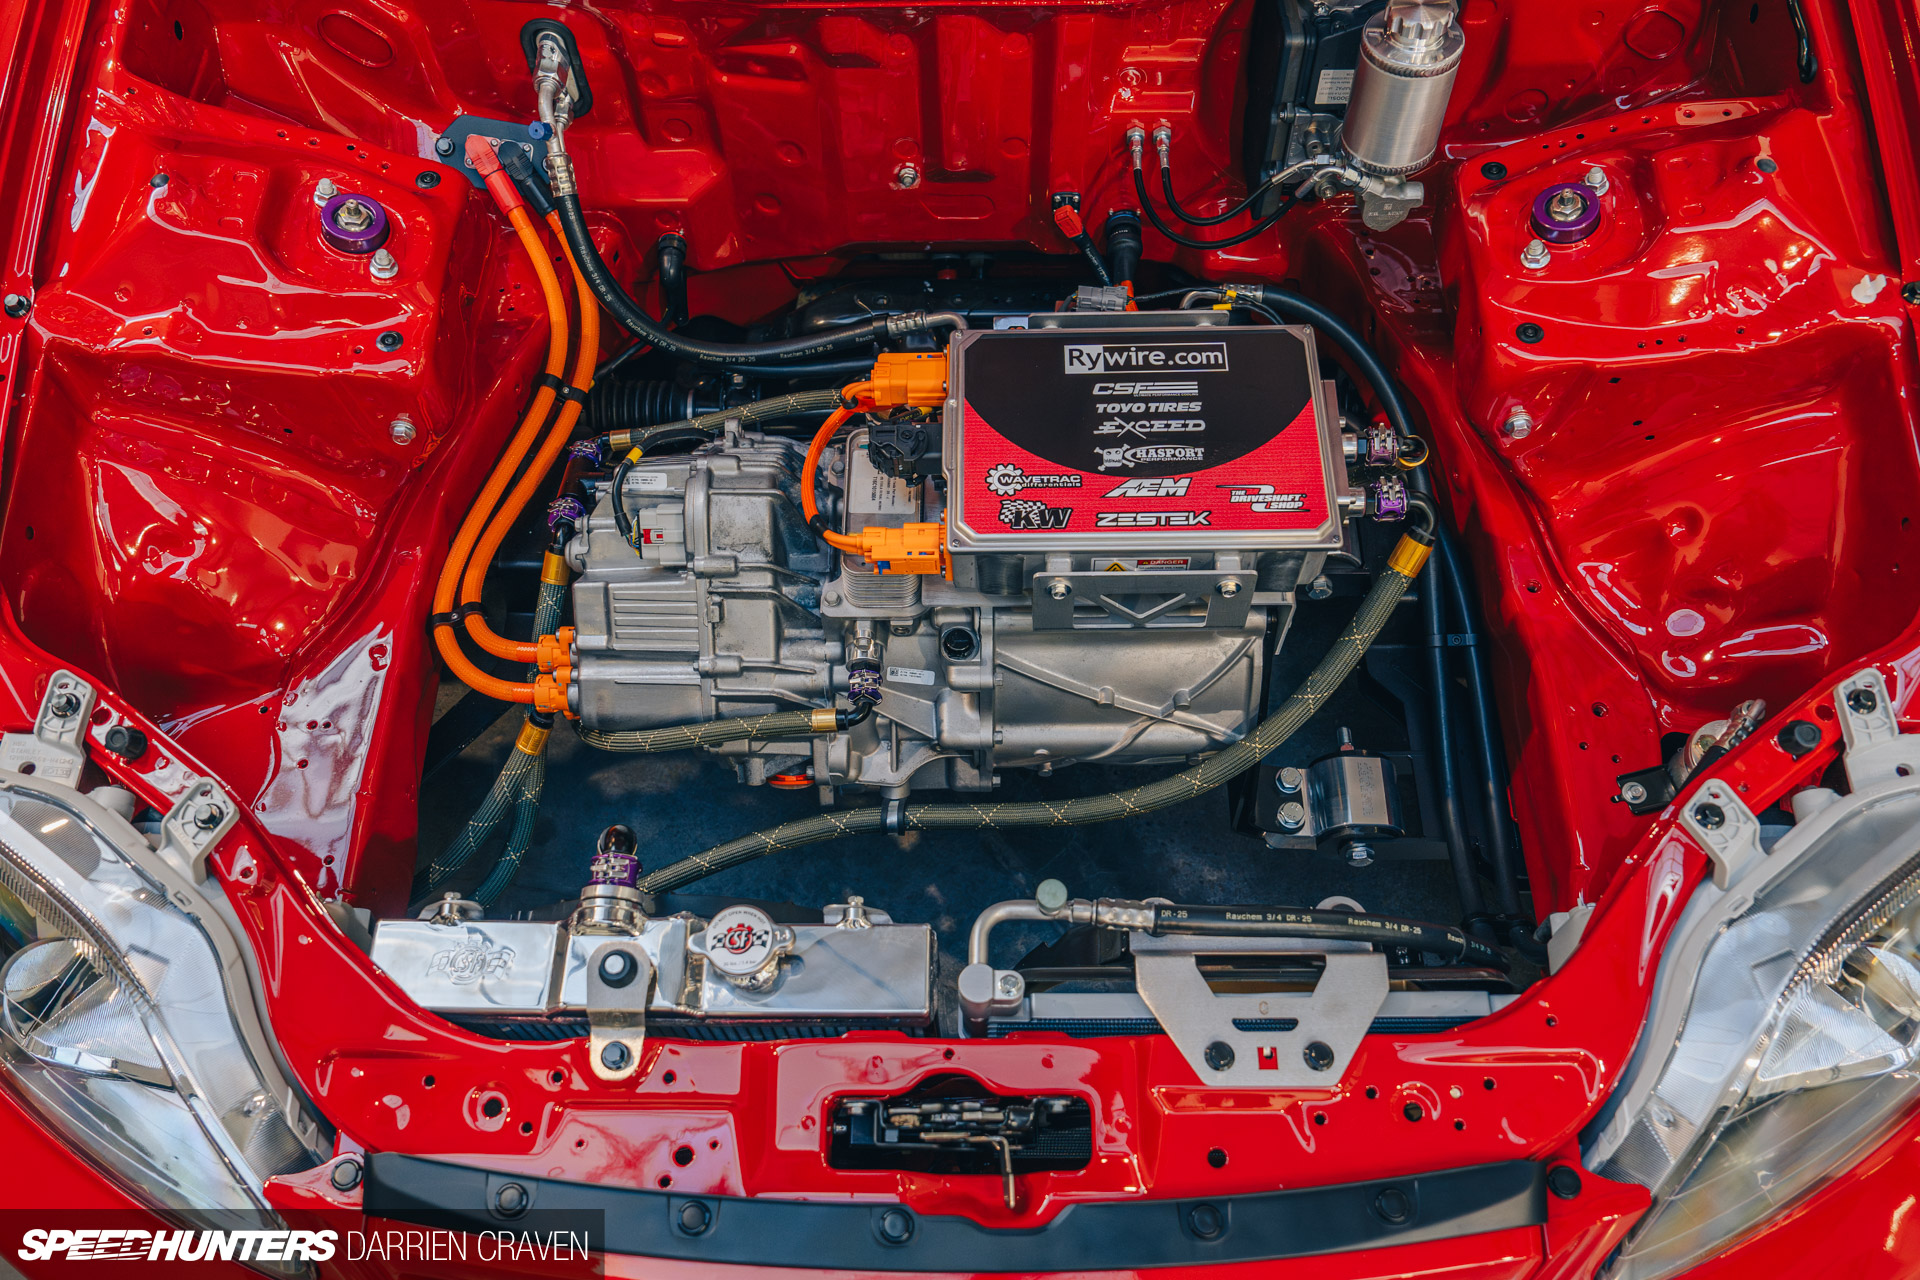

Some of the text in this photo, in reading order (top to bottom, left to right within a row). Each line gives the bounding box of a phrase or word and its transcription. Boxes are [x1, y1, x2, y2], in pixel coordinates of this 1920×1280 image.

[1068, 346, 1224, 370] Rywire.com
[1092, 382, 1198, 395] CSF
[1096, 402, 1202, 413] TOYO TIRES
[1093, 416, 1206, 440] EXCEED
[1136, 448, 1205, 458] HASPORT
[1000, 475, 1081, 484] WAVETRAC
[1100, 478, 1192, 498] AEM
[1230, 494, 1302, 502] DRIVESHAFT
[1011, 508, 1073, 530] KW
[1096, 511, 1212, 527] ZESTEK
[1160, 910, 1312, 922] DR-25 Raychem 3/4 DR-25
[1348, 917, 1422, 935] Raychem 3/4 DR-25
[726, 930, 751, 949] CSF
